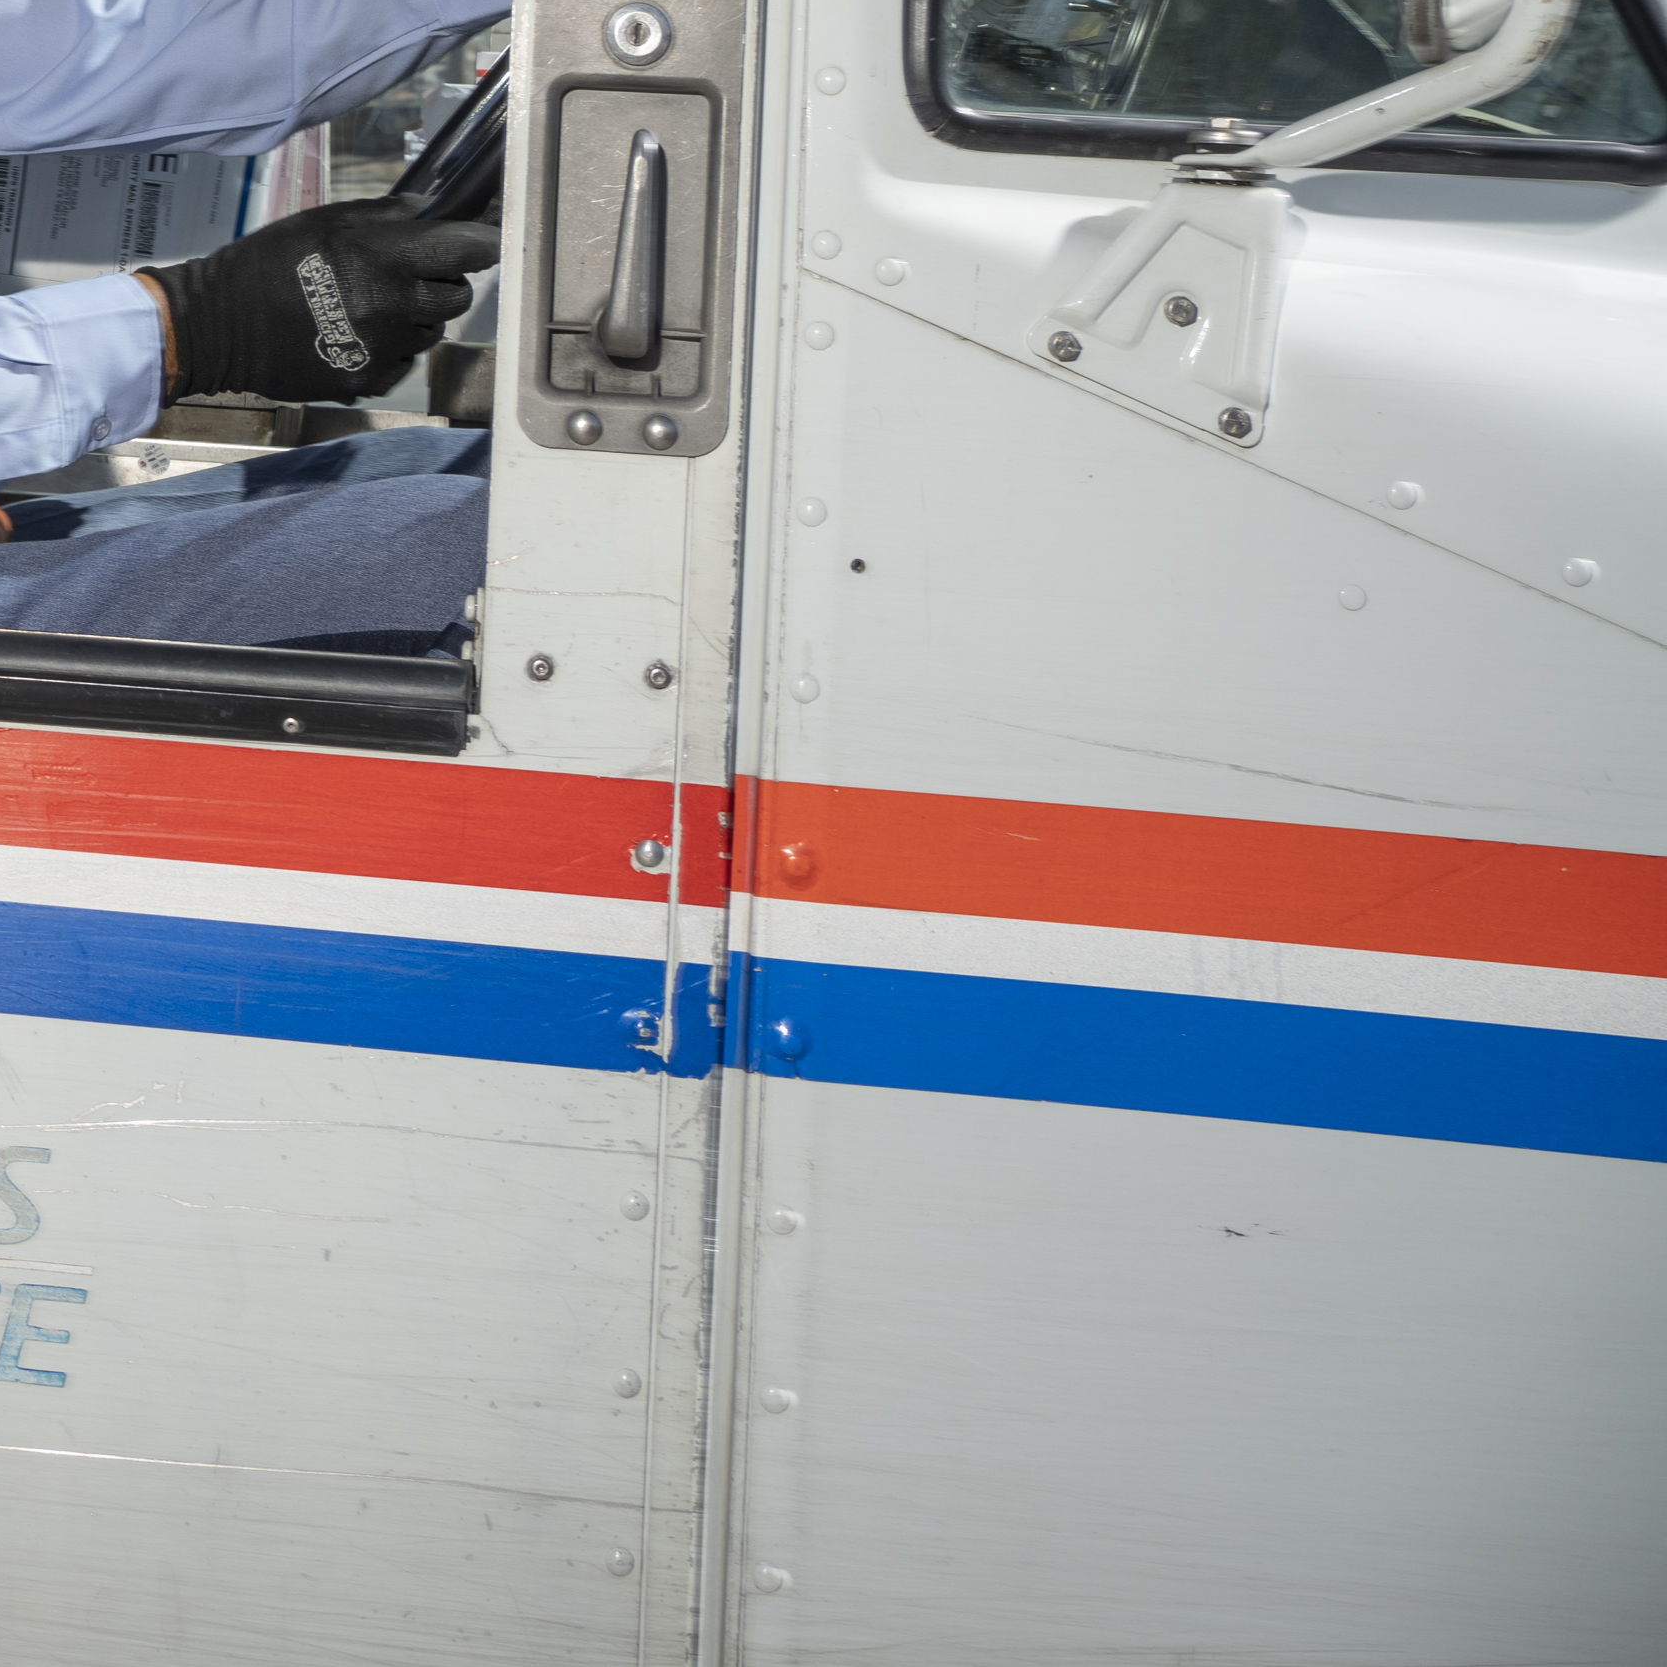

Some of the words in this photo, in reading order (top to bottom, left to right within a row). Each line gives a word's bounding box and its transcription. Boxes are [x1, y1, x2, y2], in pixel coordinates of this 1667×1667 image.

[129, 154, 142, 183] ORITY
[127, 184, 138, 205] MAIL
[121, 208, 135, 250] EXPRESS
[118, 252, 129, 274] 1-DA
